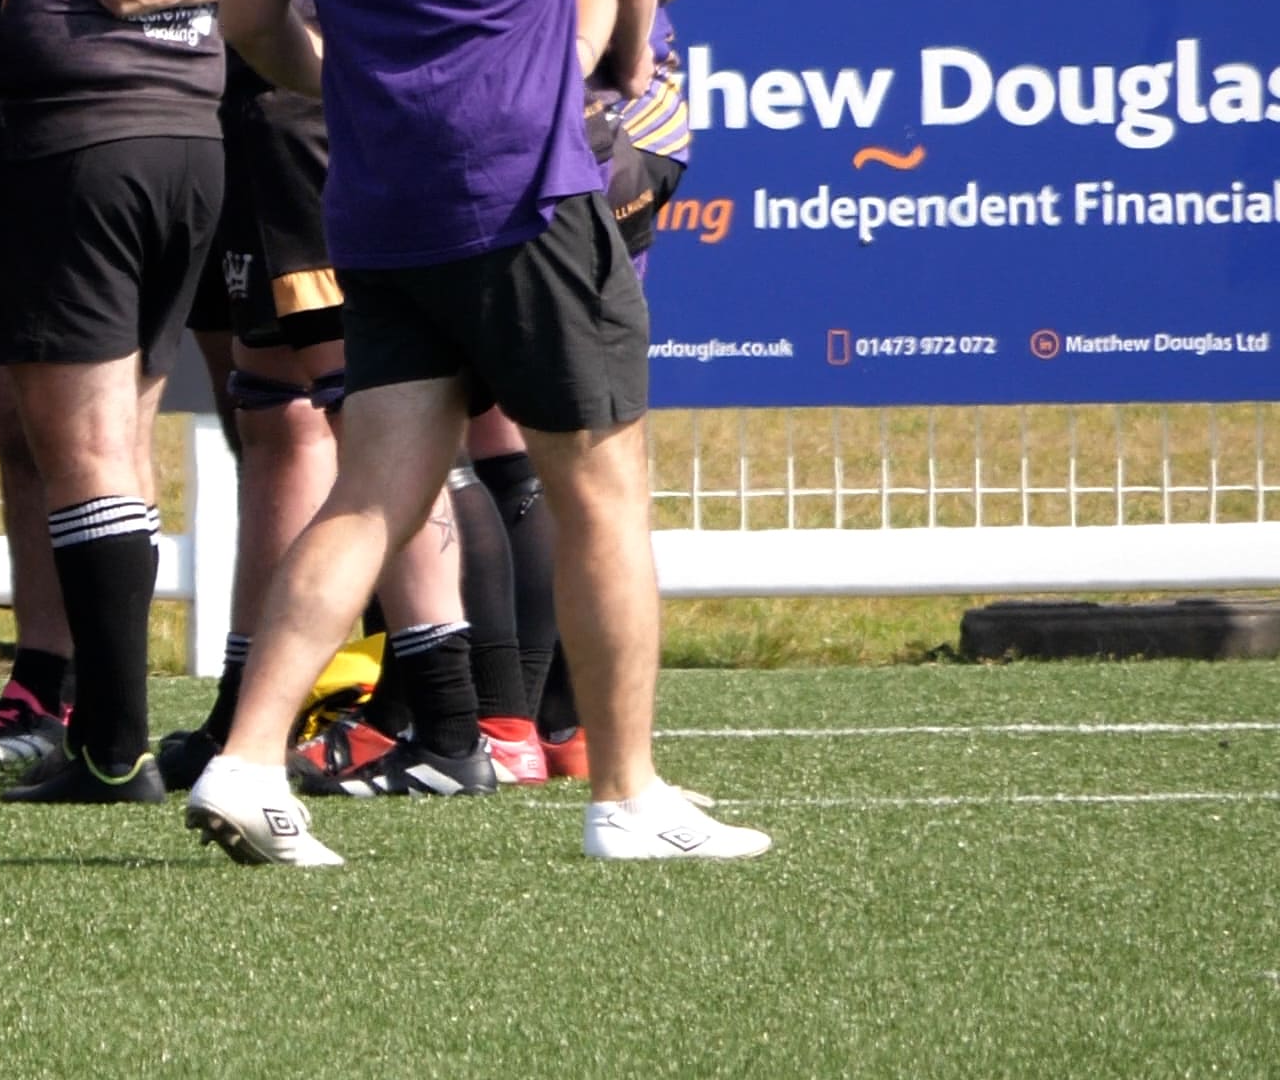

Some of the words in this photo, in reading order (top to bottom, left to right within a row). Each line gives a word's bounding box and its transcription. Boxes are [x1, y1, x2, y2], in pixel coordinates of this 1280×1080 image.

[676, 44, 894, 130] hew
[754, 183, 1062, 242] Independent
[855, 335, 917, 357] 01473
[919, 335, 957, 355] 972
[958, 335, 997, 355] 072
[1066, 334, 1150, 353] Matthew
[1154, 332, 1232, 356] Douglas
[1235, 332, 1269, 352] Ltd
